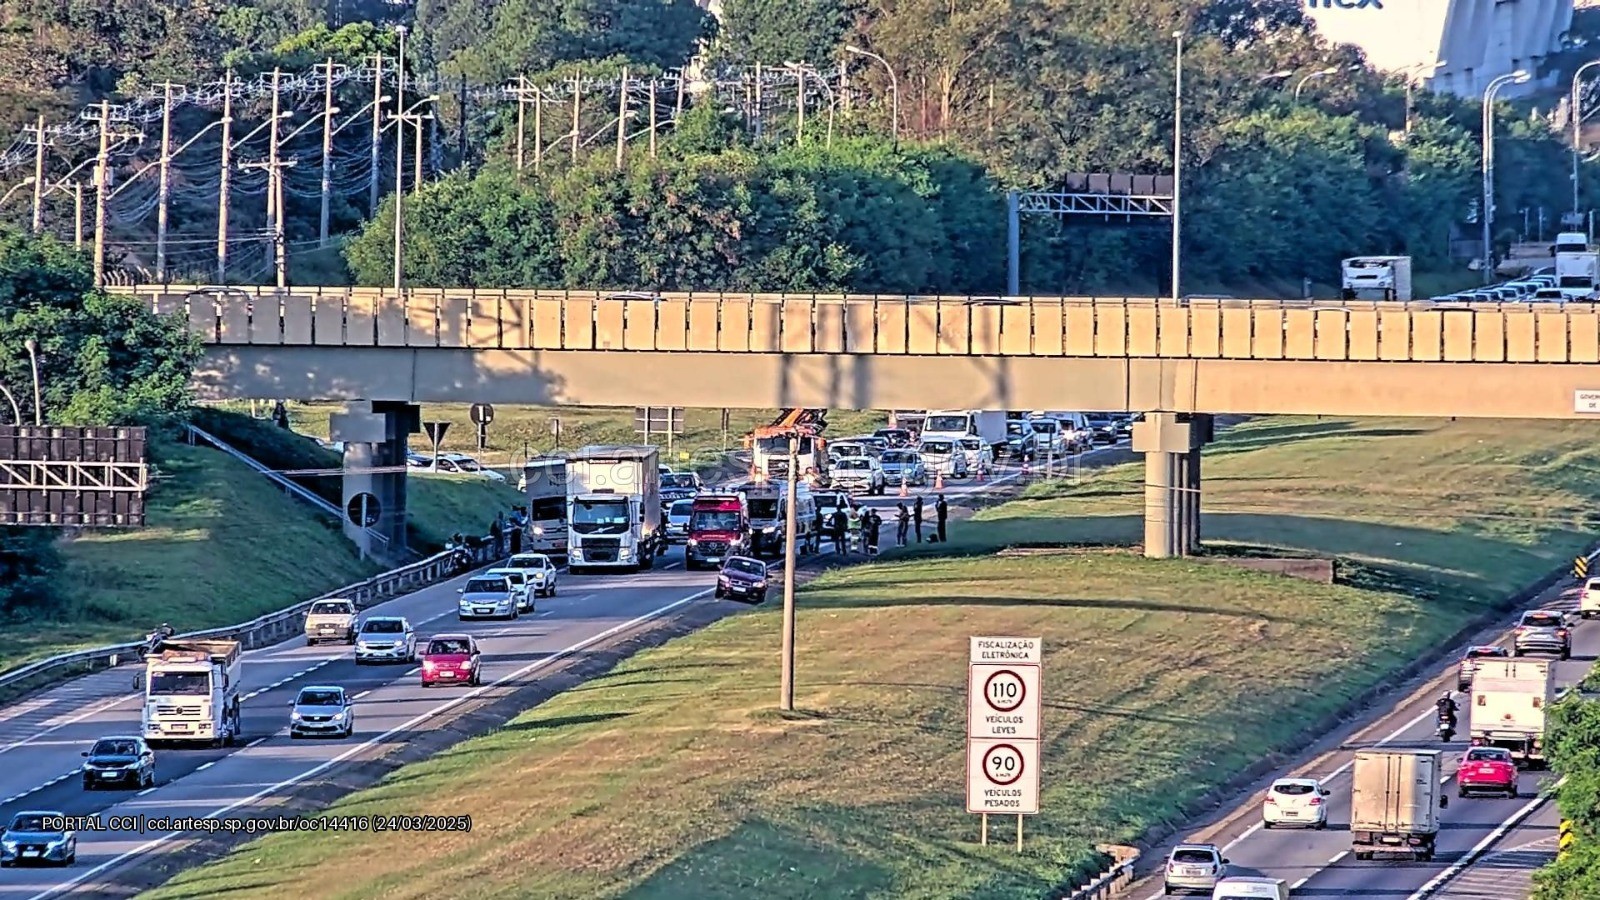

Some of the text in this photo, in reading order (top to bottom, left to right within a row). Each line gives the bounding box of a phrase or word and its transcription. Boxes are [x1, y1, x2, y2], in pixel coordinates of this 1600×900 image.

[978, 640, 1034, 649] FISCALIZAÇÃO
[982, 650, 1029, 659] ELETRÔNICA
[993, 683, 1017, 697] 110
[985, 714, 1024, 724] VEÍCULOS
[992, 756, 1015, 771] 90
[984, 787, 1022, 797] VEÍCULOS
[984, 799, 1020, 807] PESADOS
